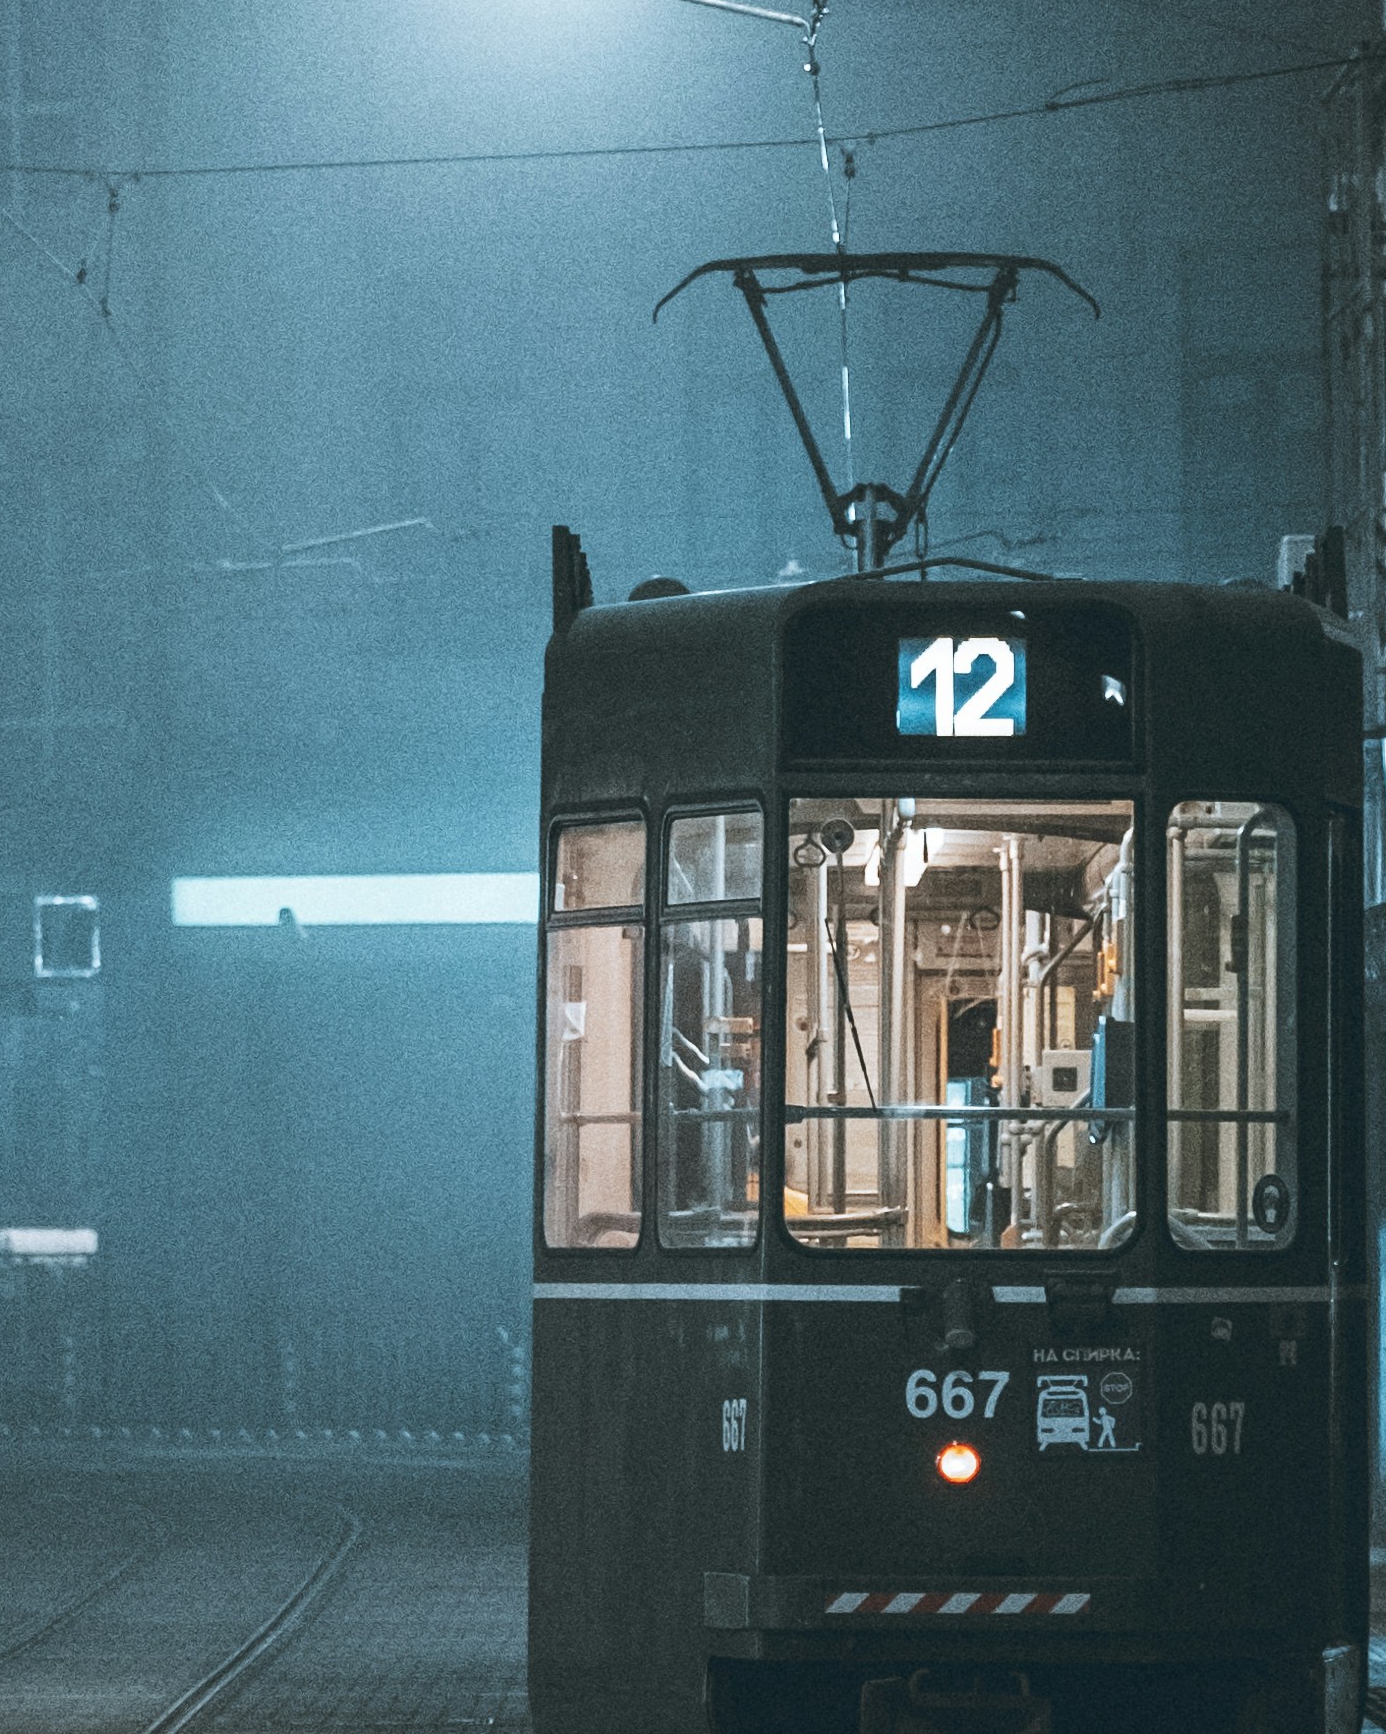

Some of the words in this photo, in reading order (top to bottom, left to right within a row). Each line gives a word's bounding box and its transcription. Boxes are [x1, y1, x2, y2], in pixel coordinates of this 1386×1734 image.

[910, 637, 1015, 737] 12
[1033, 1348, 1059, 1363] НА
[1062, 1347, 1141, 1362] СПИРКА:
[905, 1369, 1011, 1419] 667
[722, 1398, 747, 1453] 667
[1190, 1401, 1246, 1456] 667
